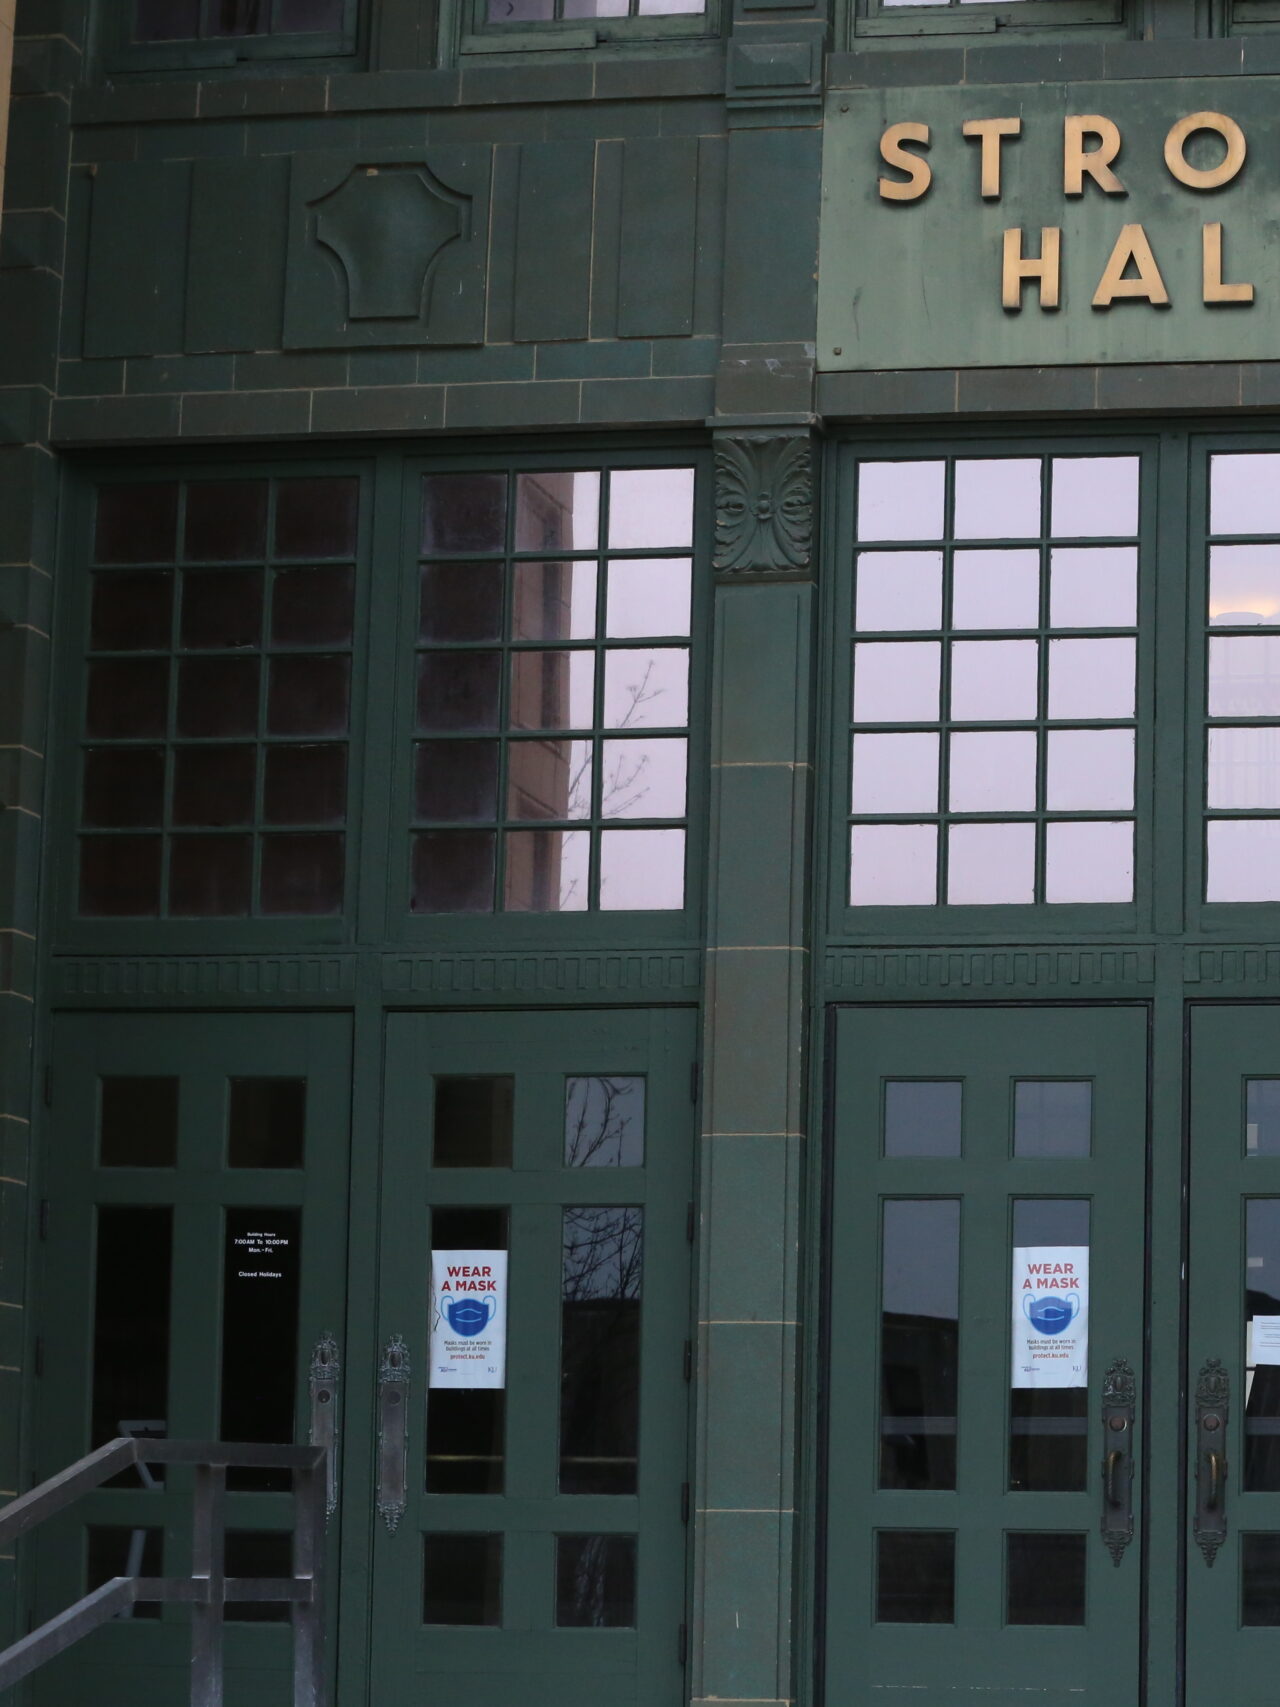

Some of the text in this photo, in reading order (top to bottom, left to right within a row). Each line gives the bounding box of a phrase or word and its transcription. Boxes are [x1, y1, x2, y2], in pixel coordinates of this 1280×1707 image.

[447, 1266, 492, 1277] WEAR
[1028, 1263, 1074, 1275] WEAR
[441, 1281, 497, 1291] A MASK
[1022, 1277, 1080, 1289] A MASK
